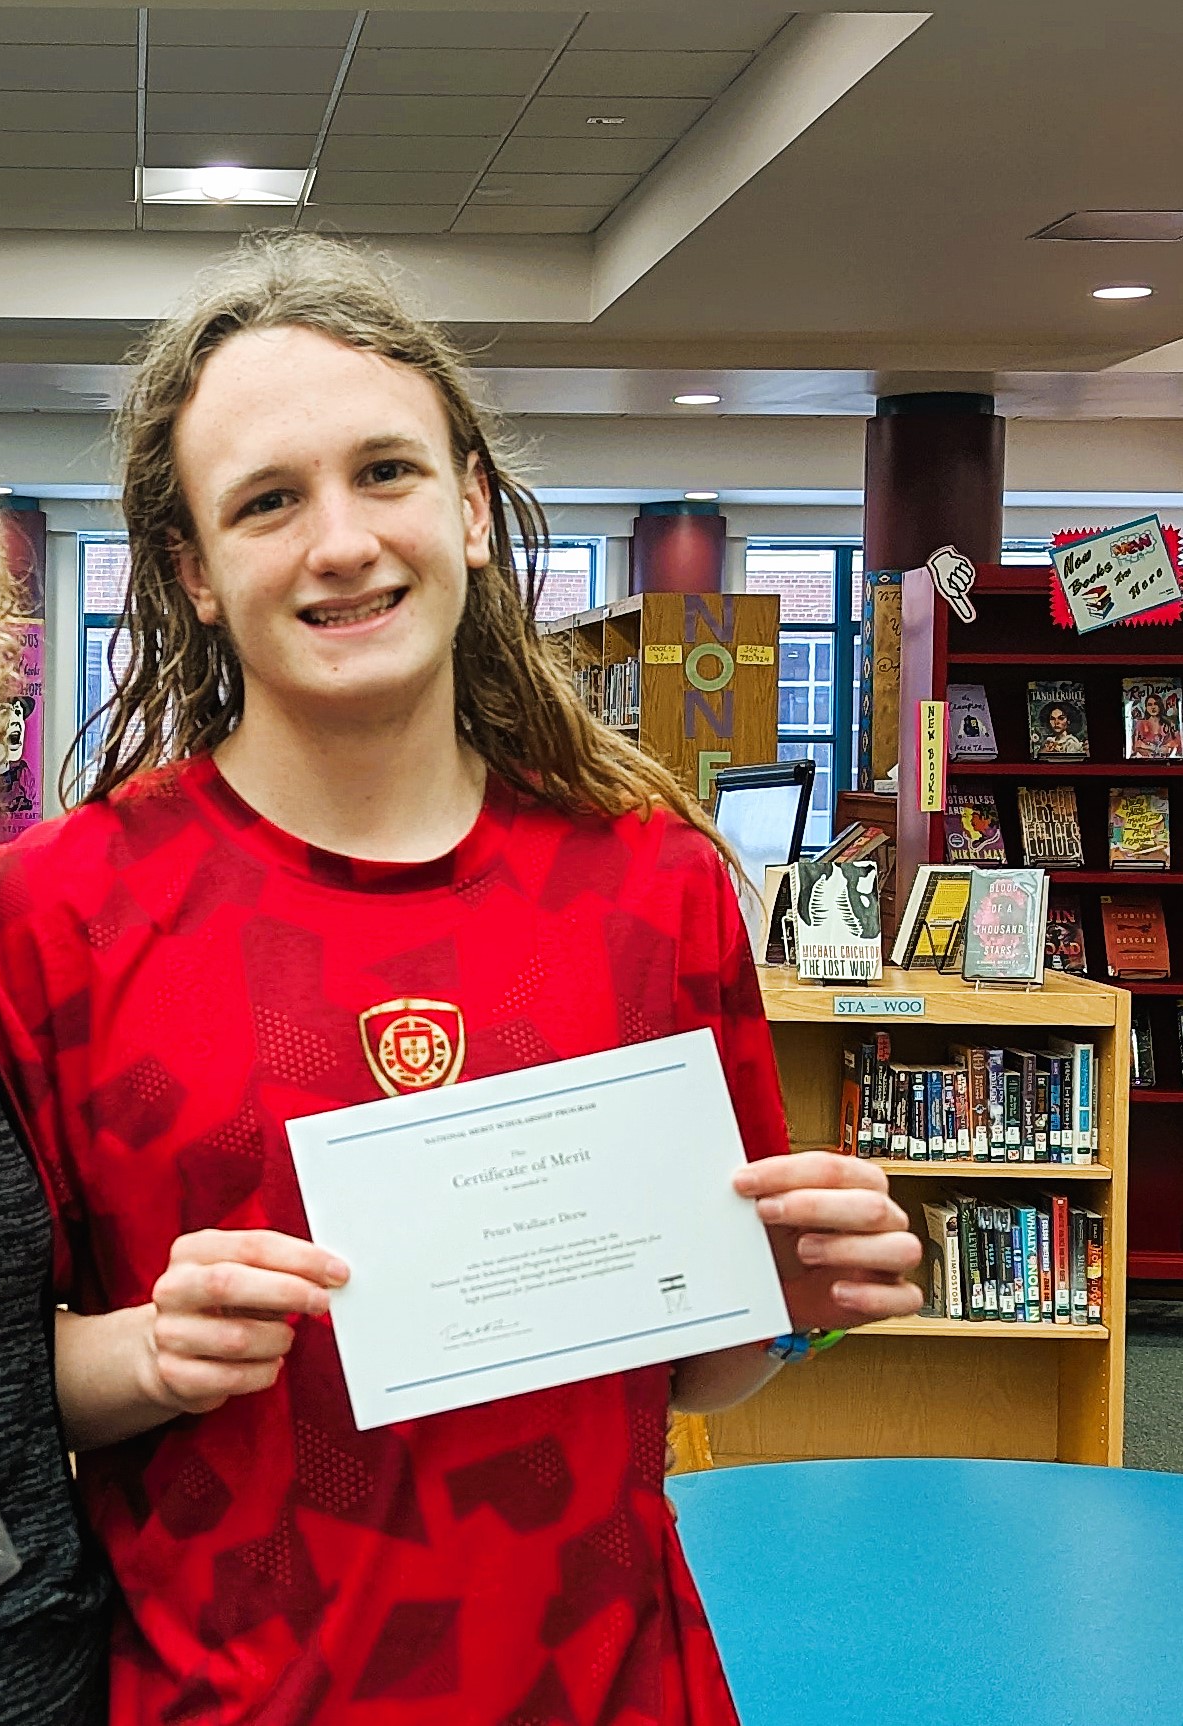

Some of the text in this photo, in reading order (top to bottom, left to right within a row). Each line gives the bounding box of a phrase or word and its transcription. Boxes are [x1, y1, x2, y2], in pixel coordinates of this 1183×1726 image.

[1026, 822, 1083, 857] ECHOES
[989, 883, 1019, 894] BLOOD
[991, 904, 1013, 914] OF A
[976, 924, 1025, 935] THOUSAND
[802, 945, 838, 959] MICHAEL
[983, 944, 1013, 956] STARS
[1046, 940, 1081, 955] OAD
[803, 960, 820, 976] THE
[823, 960, 845, 977] LOST
[838, 1001, 866, 1013] STA
[883, 1001, 922, 1013] WOO
[452, 1147, 591, 1189] Certificate of Merit
[1026, 1212, 1038, 1321] WHALEY NOIN
[1076, 1253, 1086, 1283] SILVER
